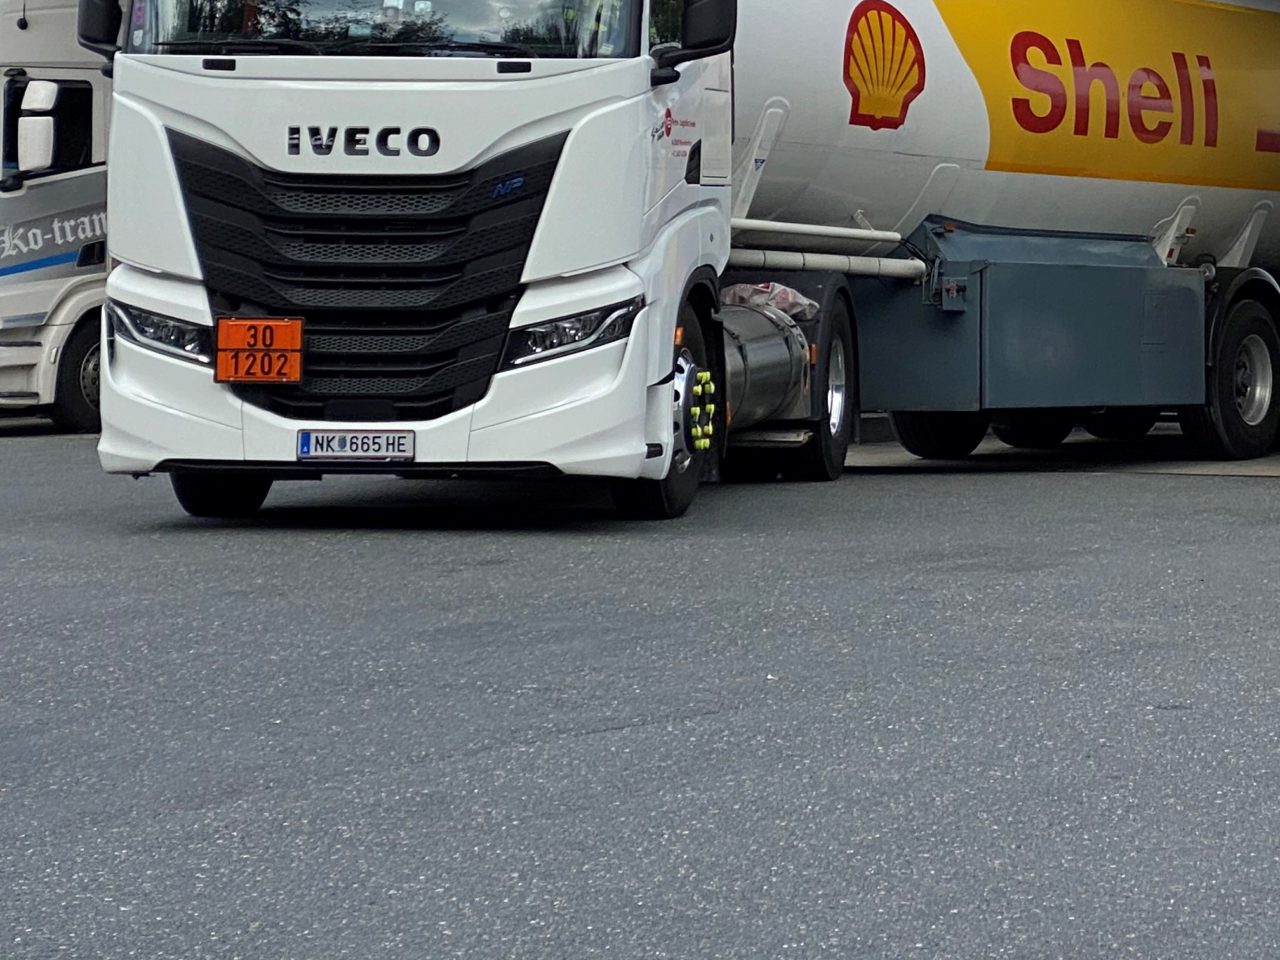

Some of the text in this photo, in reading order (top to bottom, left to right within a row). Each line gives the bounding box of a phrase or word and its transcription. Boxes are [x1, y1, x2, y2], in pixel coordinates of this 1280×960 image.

[1010, 30, 1218, 148] Shell
[287, 126, 441, 157] IVECO
[246, 324, 274, 348] 30
[231, 351, 289, 377] 1202
[314, 435, 336, 452] NK
